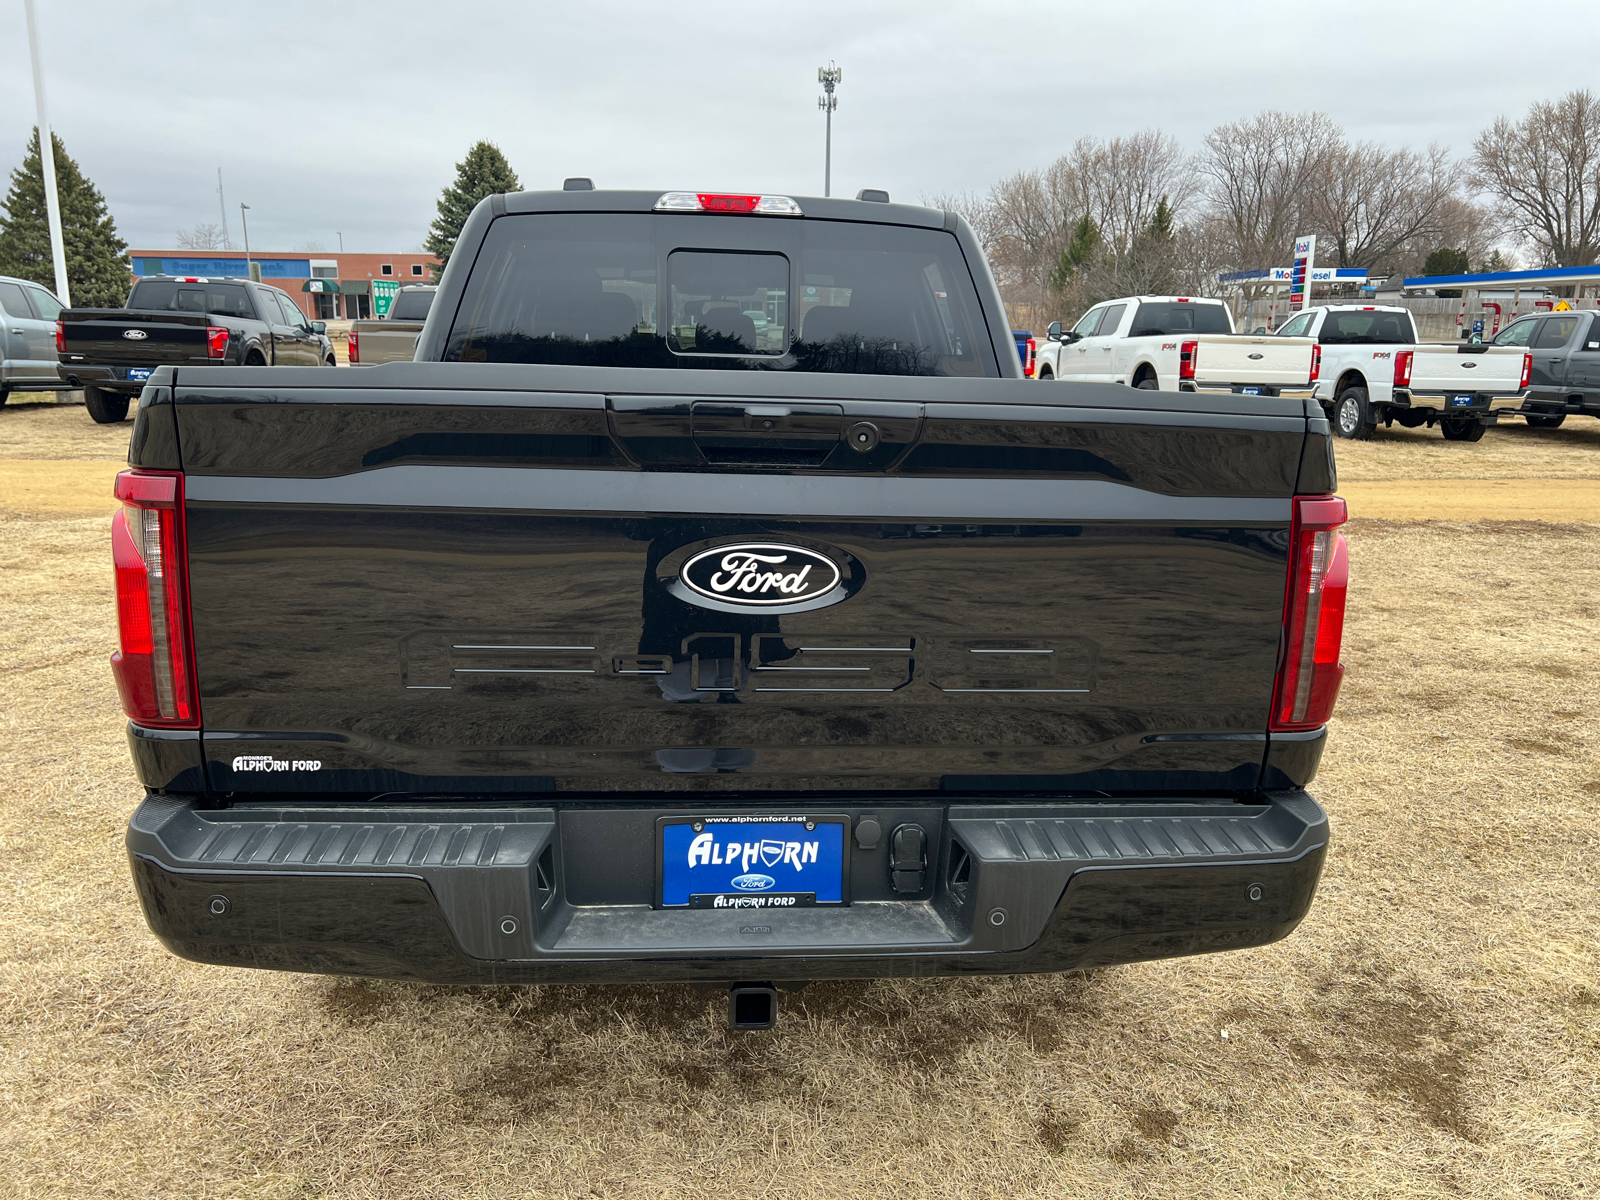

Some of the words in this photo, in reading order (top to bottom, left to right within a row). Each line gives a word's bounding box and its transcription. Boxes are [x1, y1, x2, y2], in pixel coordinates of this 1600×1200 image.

[1296, 241, 1310, 254] Mobil
[172, 261, 209, 272] Sugar
[213, 261, 246, 270] River
[1161, 343, 1177, 351] FX4
[1372, 352, 1391, 360] FX4
[710, 552, 812, 594] Ford
[292, 760, 322, 772] FORD
[704, 815, 807, 824] www.alphornford.net
[687, 832, 820, 873] ALPHORN
[739, 876, 768, 889] Ford
[713, 894, 766, 909] ALPHORN
[768, 896, 796, 906] FORD
